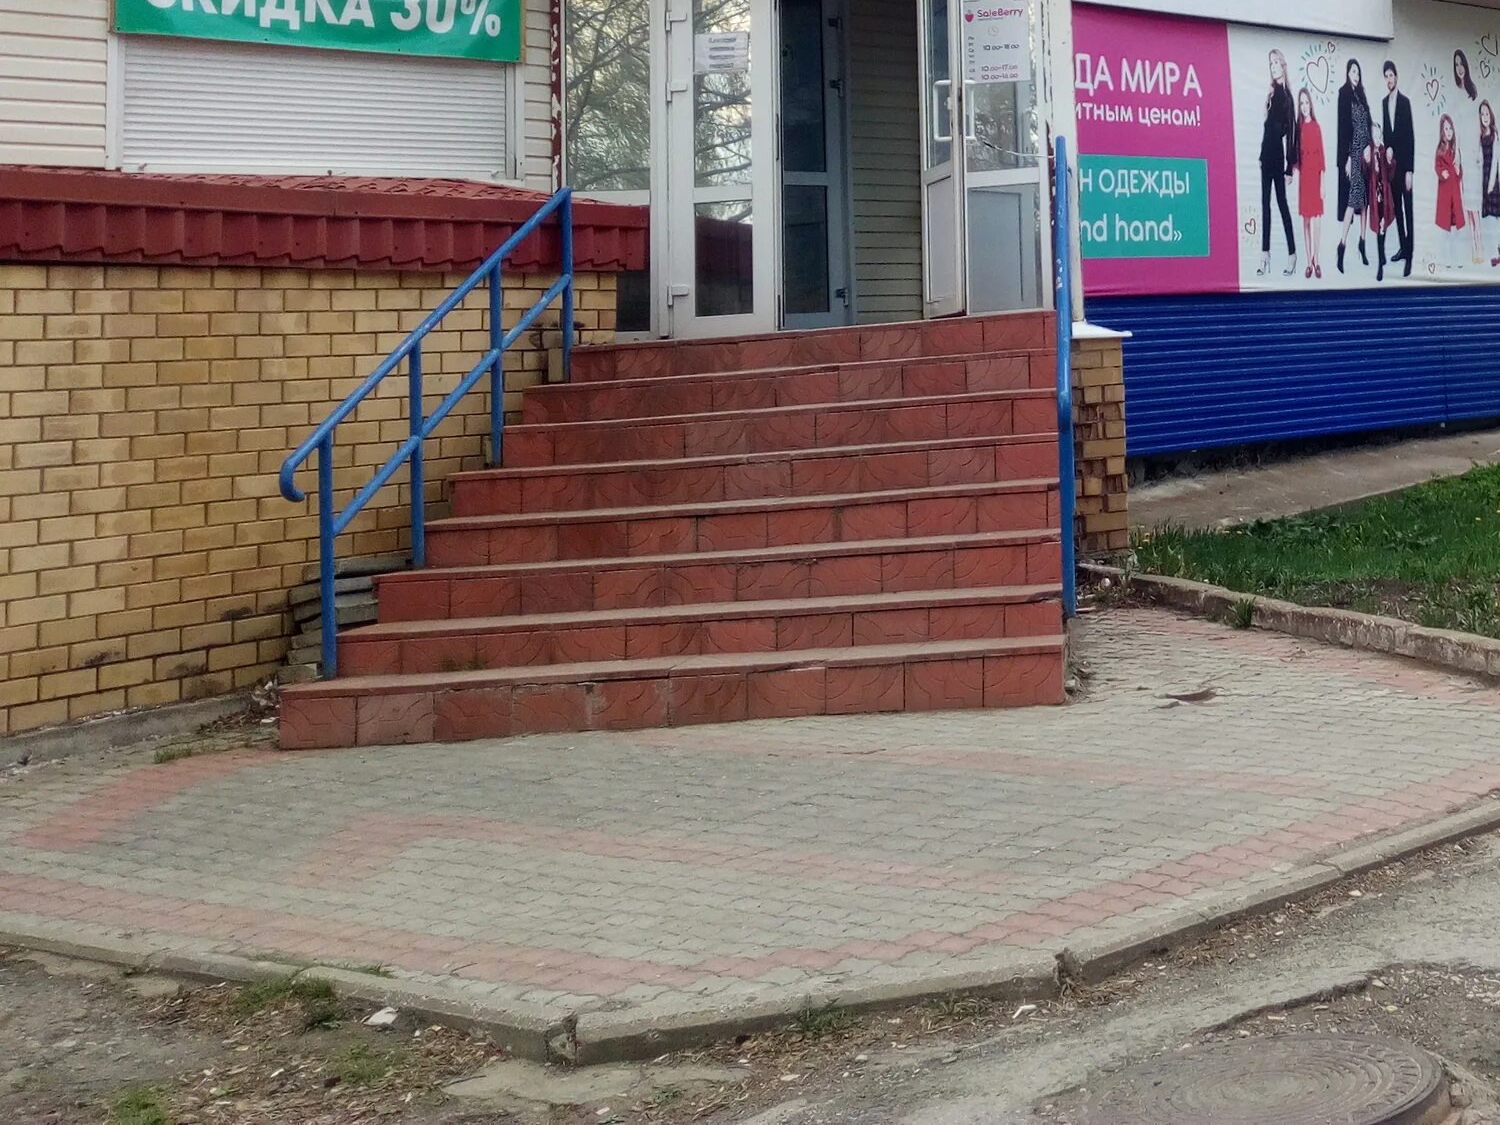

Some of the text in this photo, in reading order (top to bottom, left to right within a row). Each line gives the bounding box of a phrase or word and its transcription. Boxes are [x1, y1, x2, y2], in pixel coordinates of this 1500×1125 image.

[977, 8, 1024, 17] SaleBerry
[1121, 57, 1202, 98] МИРА
[1138, 105, 1201, 127] ценам!
[1099, 168, 1190, 198] ОДЕЖДЫ
